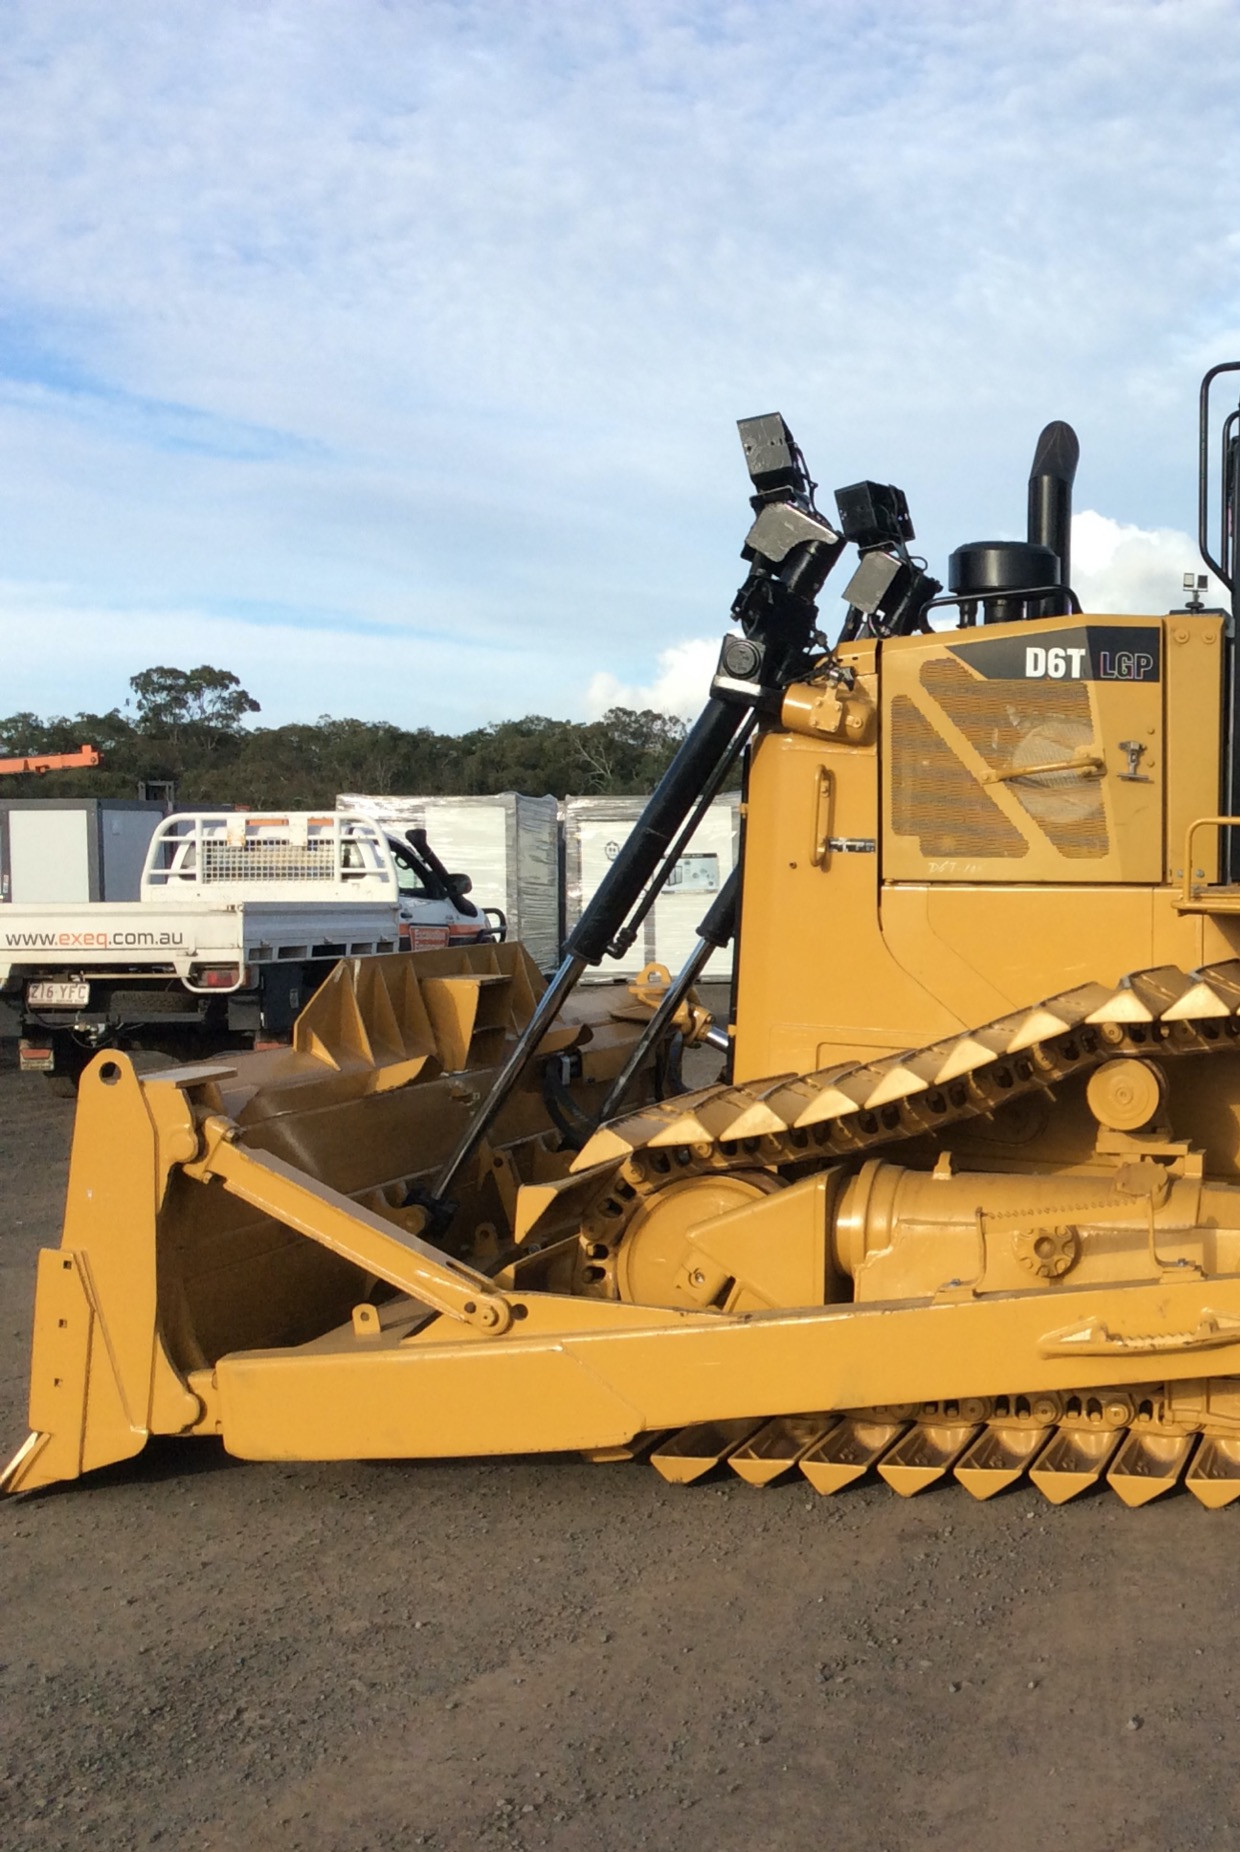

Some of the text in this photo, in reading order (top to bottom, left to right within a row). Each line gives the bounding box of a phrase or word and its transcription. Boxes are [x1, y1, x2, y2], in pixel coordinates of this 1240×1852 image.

[1025, 646, 1153, 680] D6T LGP
[5, 931, 183, 949] www.exeq.com.au
